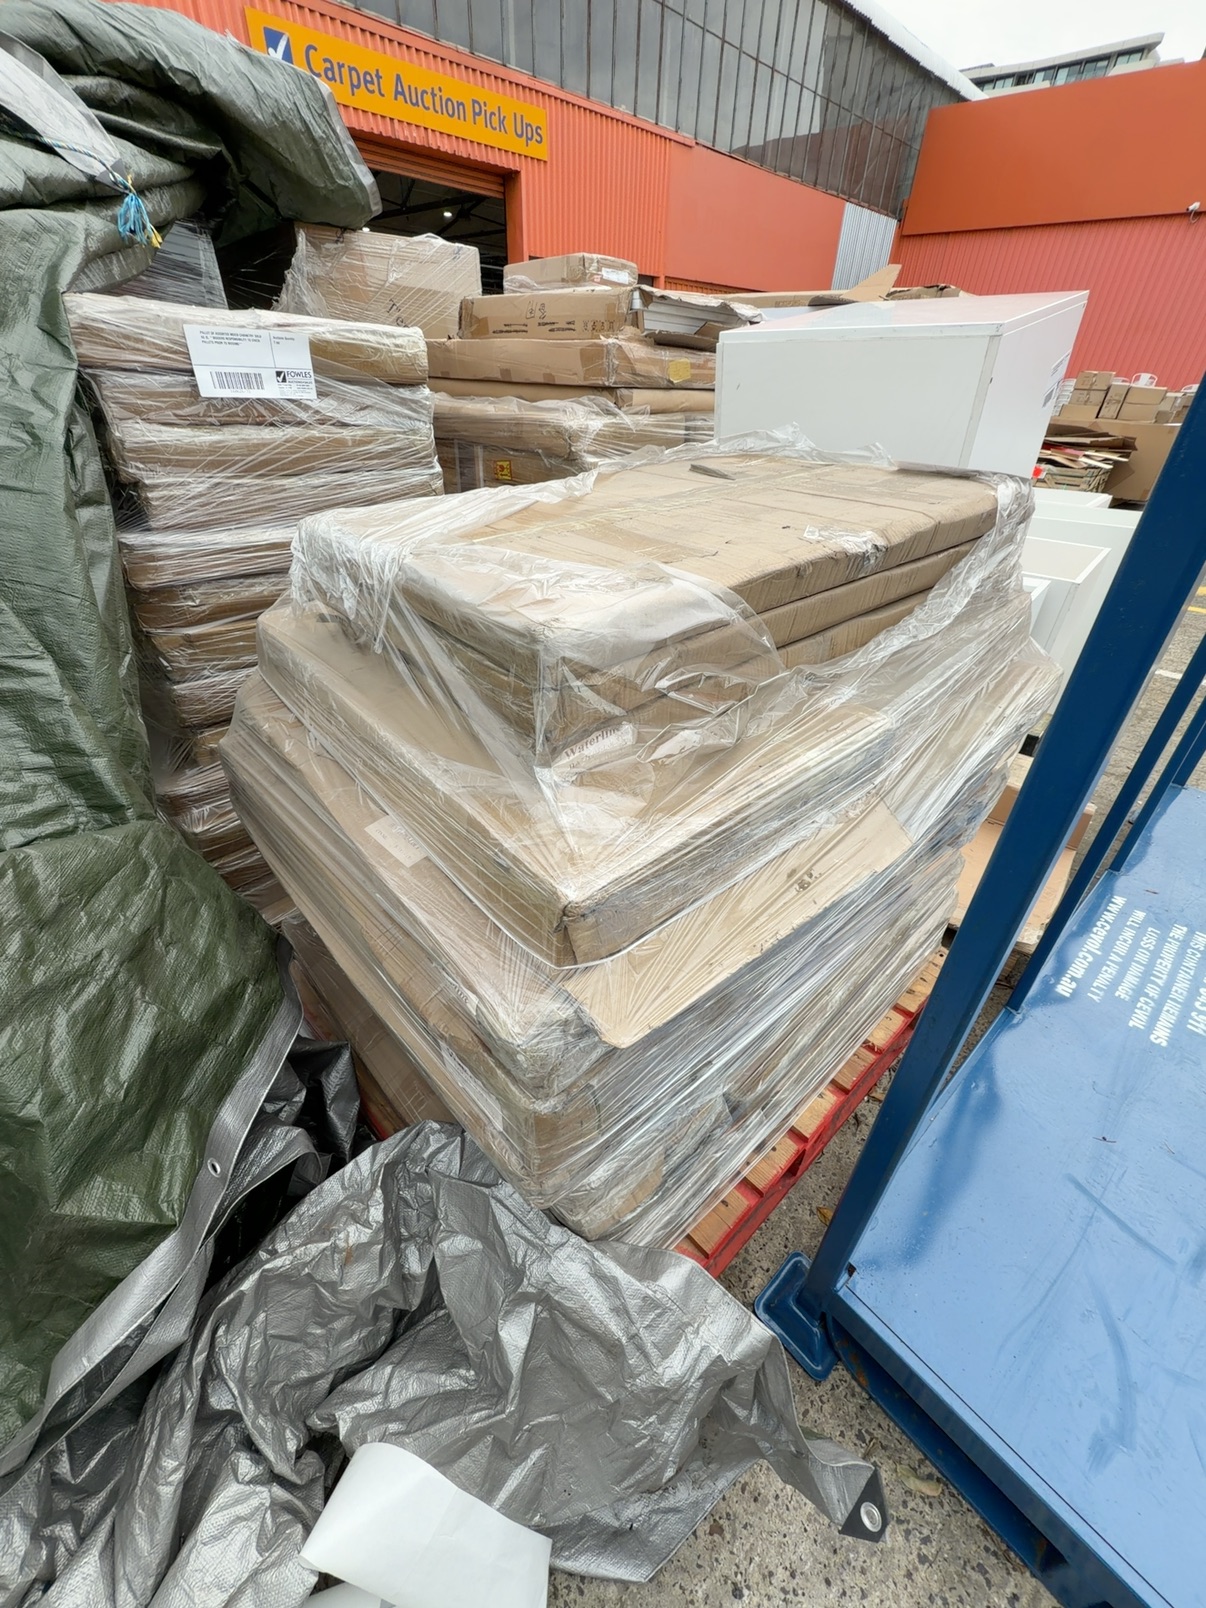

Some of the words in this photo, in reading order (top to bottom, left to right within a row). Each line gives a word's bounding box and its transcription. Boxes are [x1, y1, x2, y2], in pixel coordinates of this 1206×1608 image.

[304, 44, 385, 98] Carpet
[394, 73, 467, 123] Auction
[472, 98, 508, 135] Pick
[513, 112, 544, 147] Ups
[286, 370, 312, 379] FOWLES
[1126, 909, 1147, 928] WILL
[1168, 923, 1188, 942] THE
[1055, 895, 1127, 998] www.cevol.com.au
[1112, 926, 1137, 956] INCUR
[1140, 927, 1161, 951] LOSS
[1108, 952, 1123, 963] A
[1133, 949, 1151, 965] OR
[1149, 938, 1181, 987] PROPERTY
[1087, 960, 1120, 1003] PENALTY
[1114, 962, 1145, 1001] DAMAGE
[1144, 983, 1161, 1000] OF
[1169, 948, 1202, 1003] CONTAINER
[1128, 996, 1157, 1030] CEVOL
[1149, 999, 1182, 1047] REMAINS
